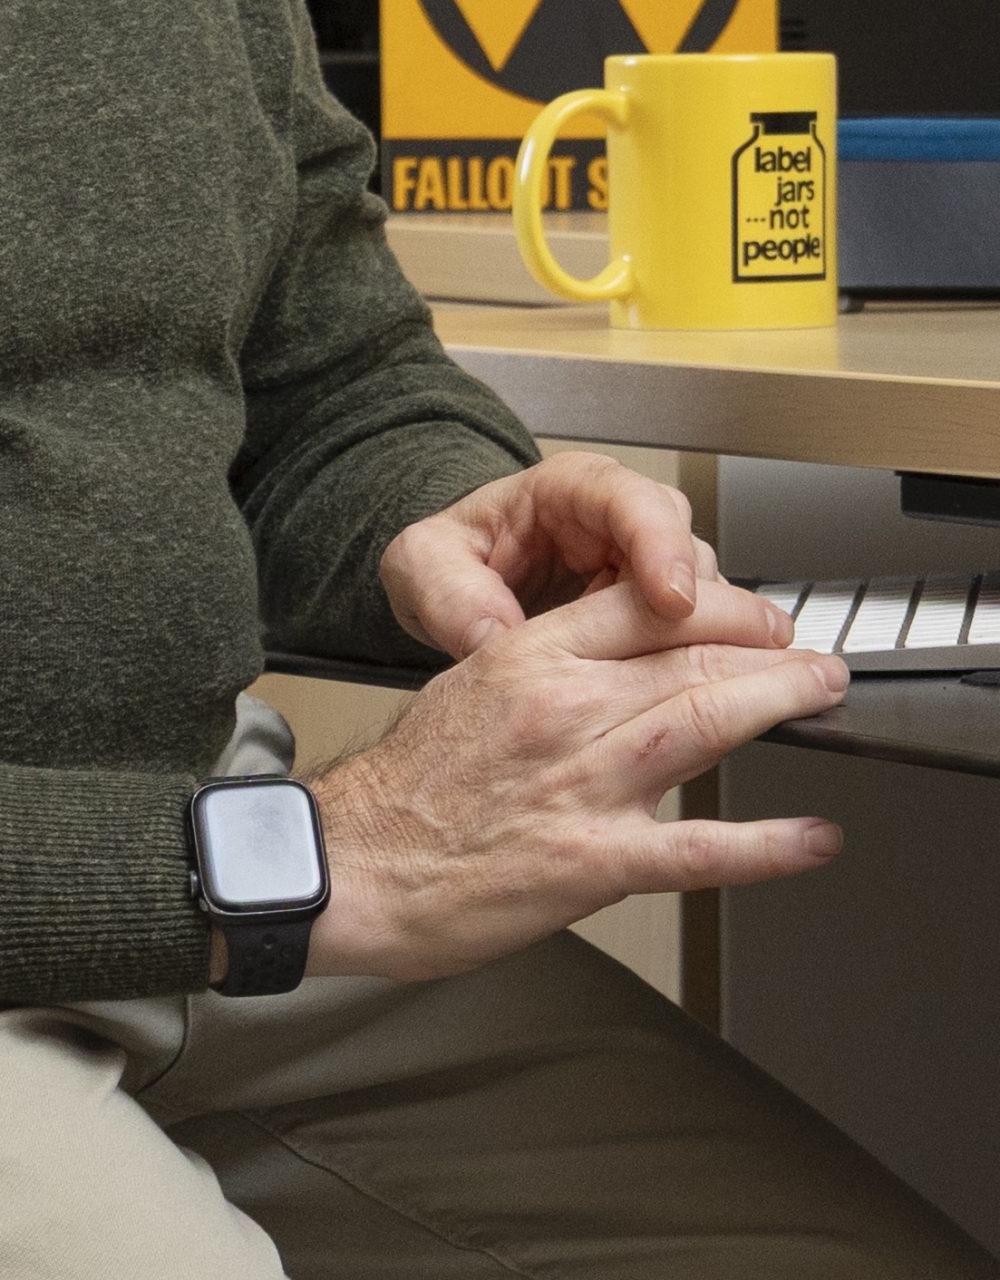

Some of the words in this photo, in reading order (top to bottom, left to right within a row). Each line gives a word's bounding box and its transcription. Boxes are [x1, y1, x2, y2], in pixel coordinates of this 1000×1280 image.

[755, 146, 811, 173] label
[774, 177, 815, 206] jars
[743, 234, 820, 267] people
